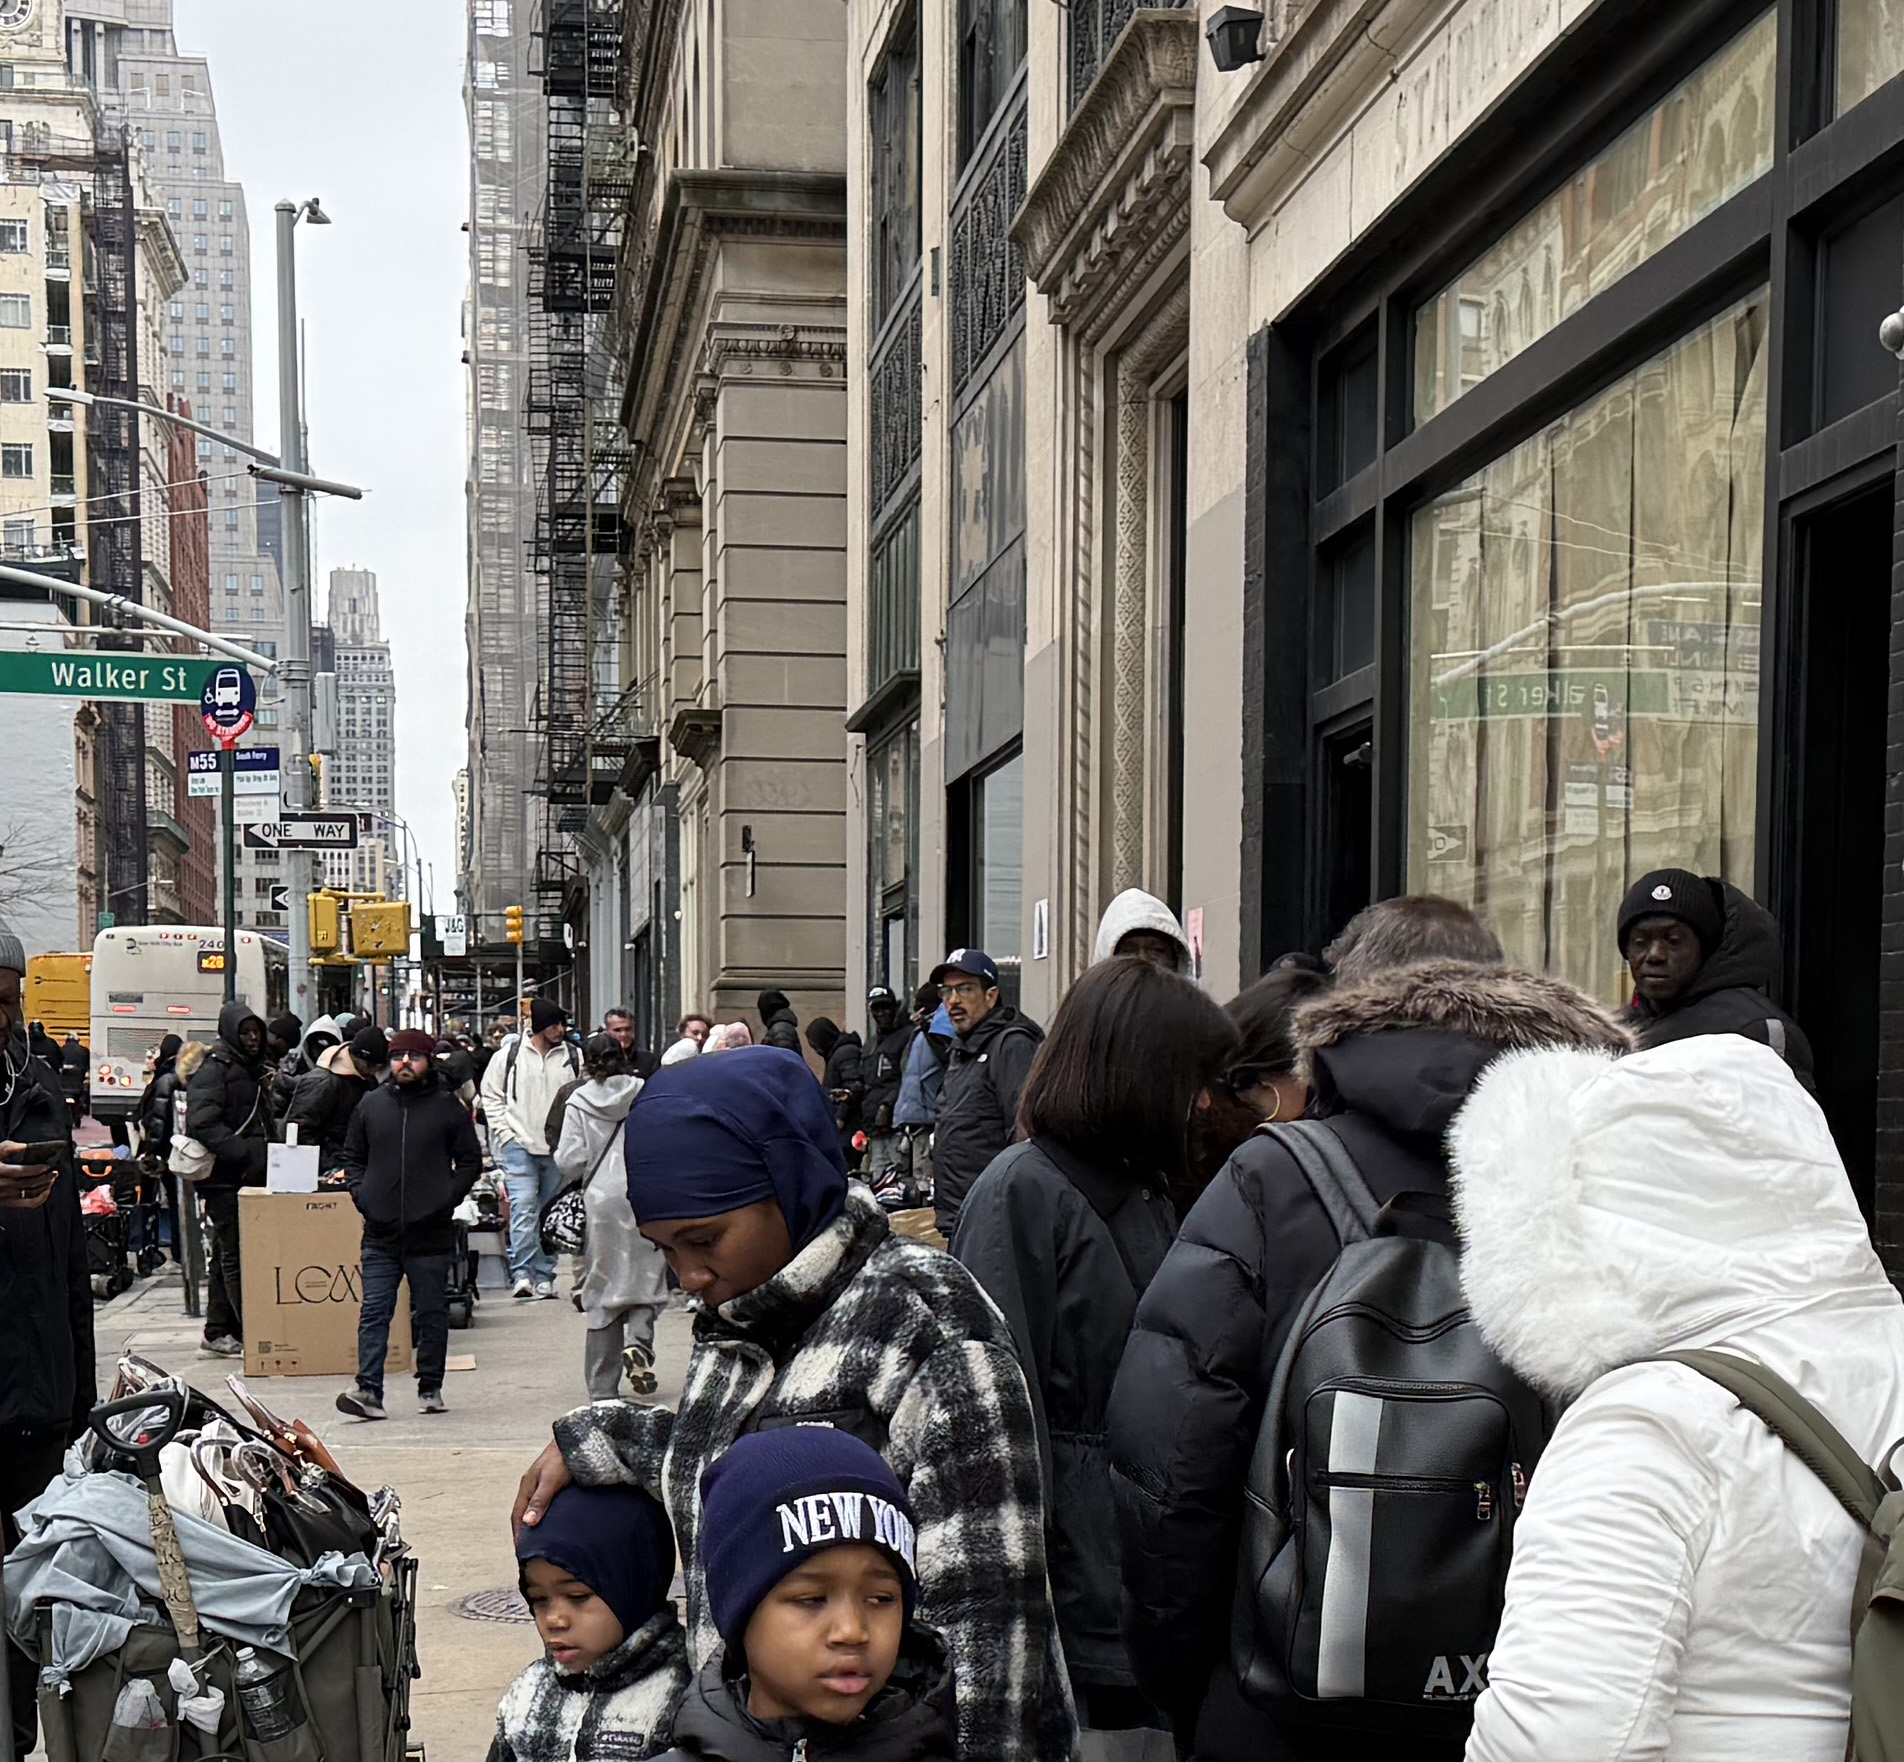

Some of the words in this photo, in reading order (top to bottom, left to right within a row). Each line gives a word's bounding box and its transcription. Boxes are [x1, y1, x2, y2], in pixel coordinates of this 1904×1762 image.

[51, 661, 150, 690] Walker
[162, 666, 187, 691] St
[190, 753, 217, 770] M55
[262, 823, 293, 837] ONE
[314, 824, 345, 838] WAY
[775, 1491, 864, 1553] NEW
[865, 1493, 917, 1580] YOR
